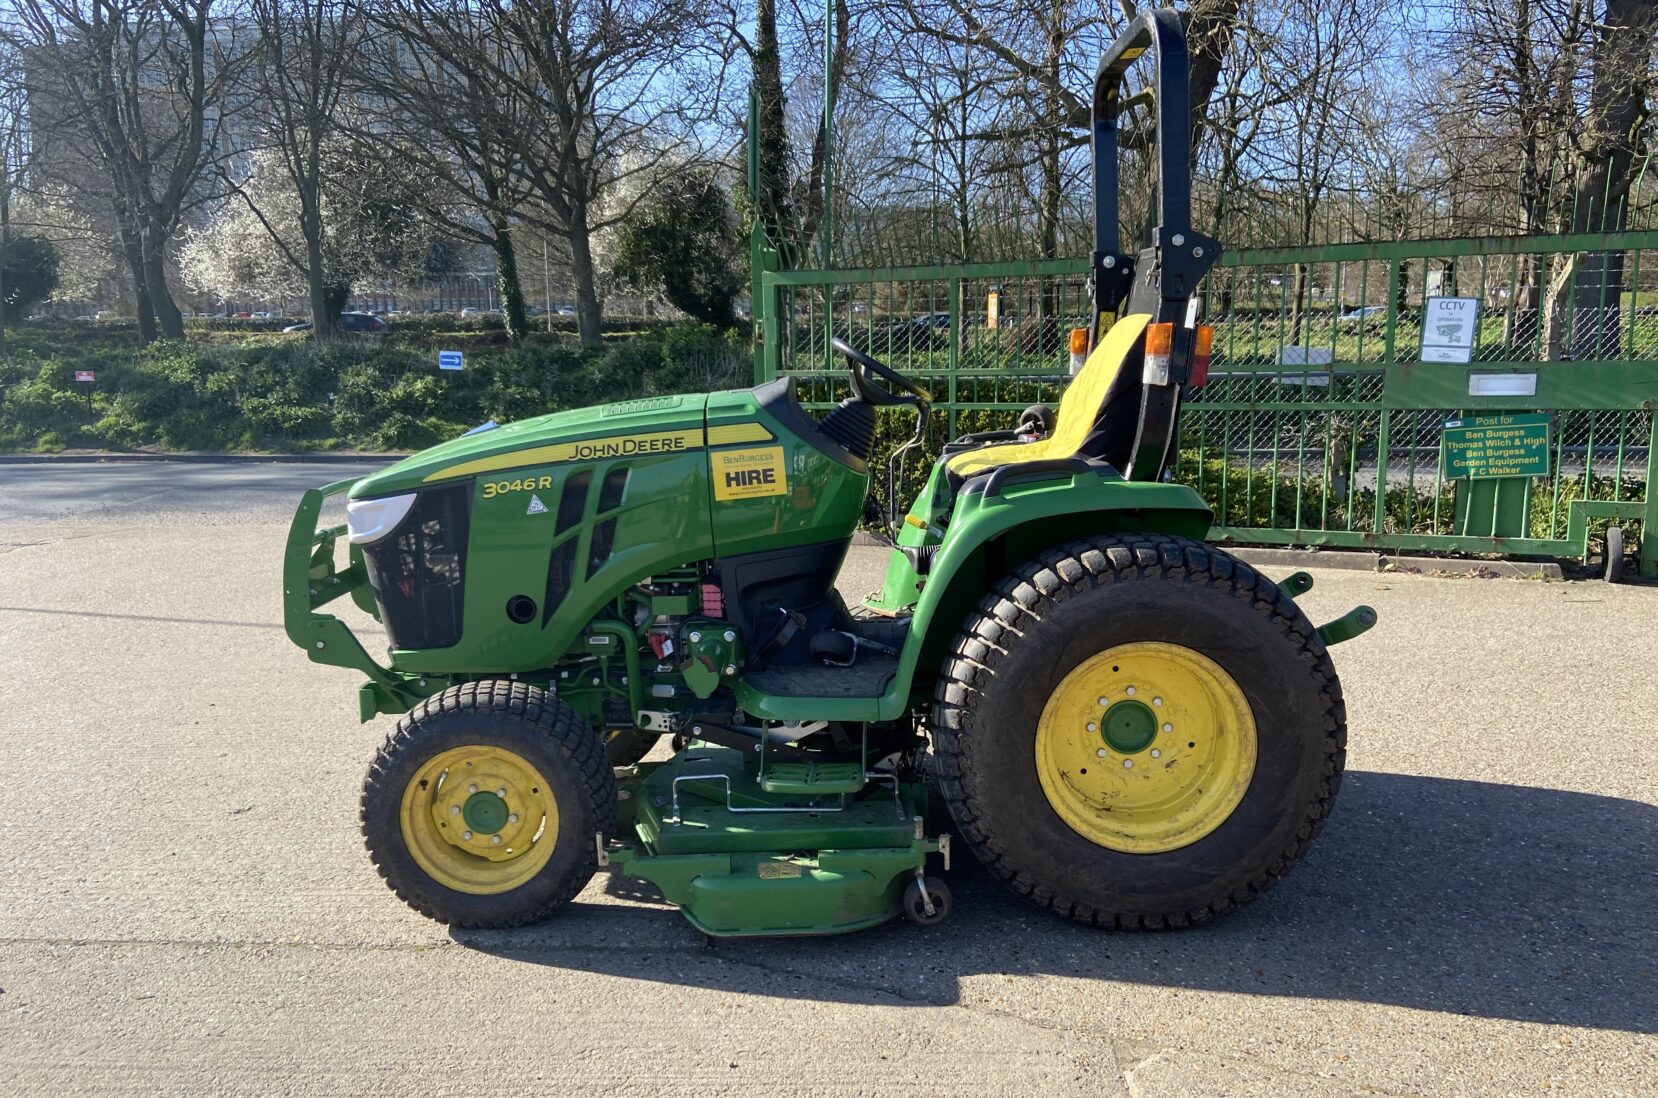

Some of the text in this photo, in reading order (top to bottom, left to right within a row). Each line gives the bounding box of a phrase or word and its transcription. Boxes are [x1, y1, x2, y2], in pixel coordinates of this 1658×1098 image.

[1439, 301, 1465, 311] CCTV
[1476, 416, 1515, 426] Post for
[1465, 429, 1525, 440] Ben Burgess
[568, 436, 685, 460] JOHN DEERE
[1447, 441, 1483, 450] Thomas
[1513, 438, 1521, 446] &
[1523, 437, 1546, 447] High
[1466, 447, 1525, 458] Ben Burgess
[1453, 456, 1539, 468] Garden Equipment
[1488, 466, 1521, 475] Walker
[725, 468, 776, 488] HIRE
